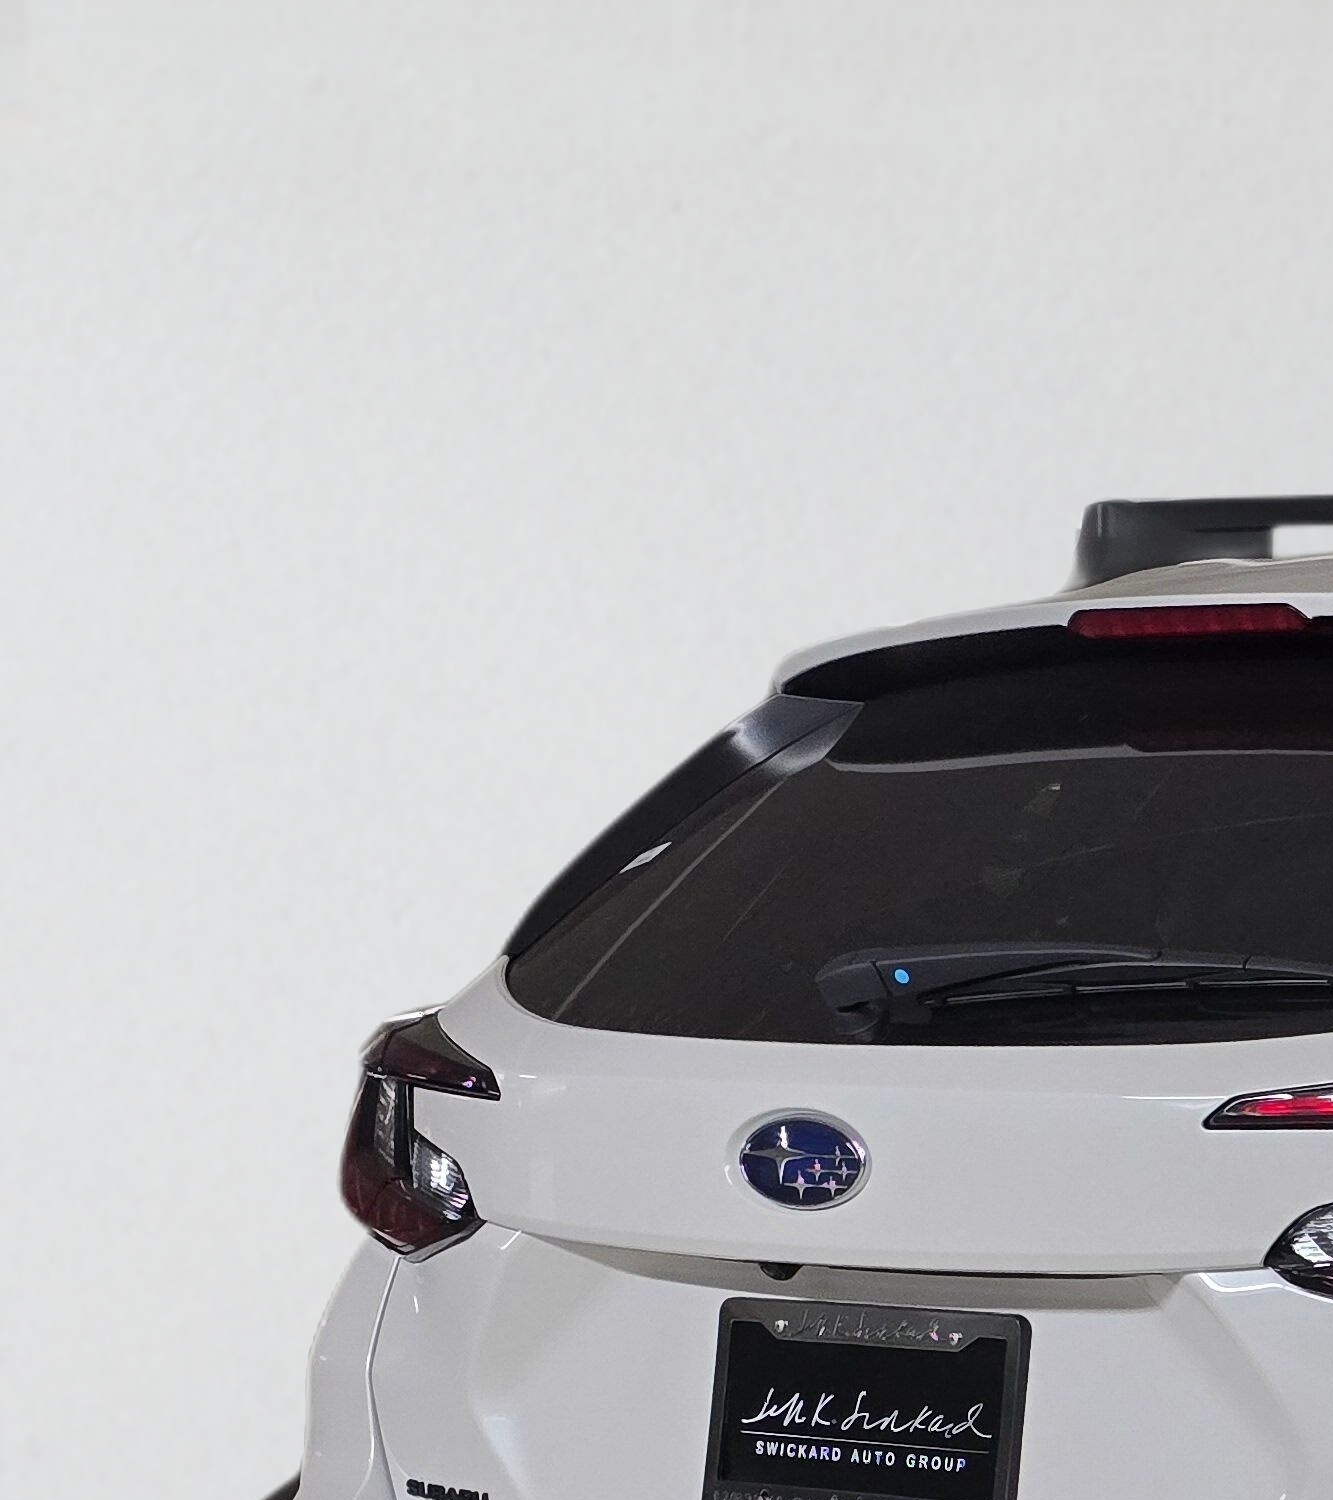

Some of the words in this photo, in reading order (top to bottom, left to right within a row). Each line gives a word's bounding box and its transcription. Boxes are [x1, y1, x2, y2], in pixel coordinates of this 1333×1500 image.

[755, 1440, 842, 1462] SWICKARD
[850, 1448, 896, 1467] AUTO
[906, 1453, 966, 1473] GROUP
